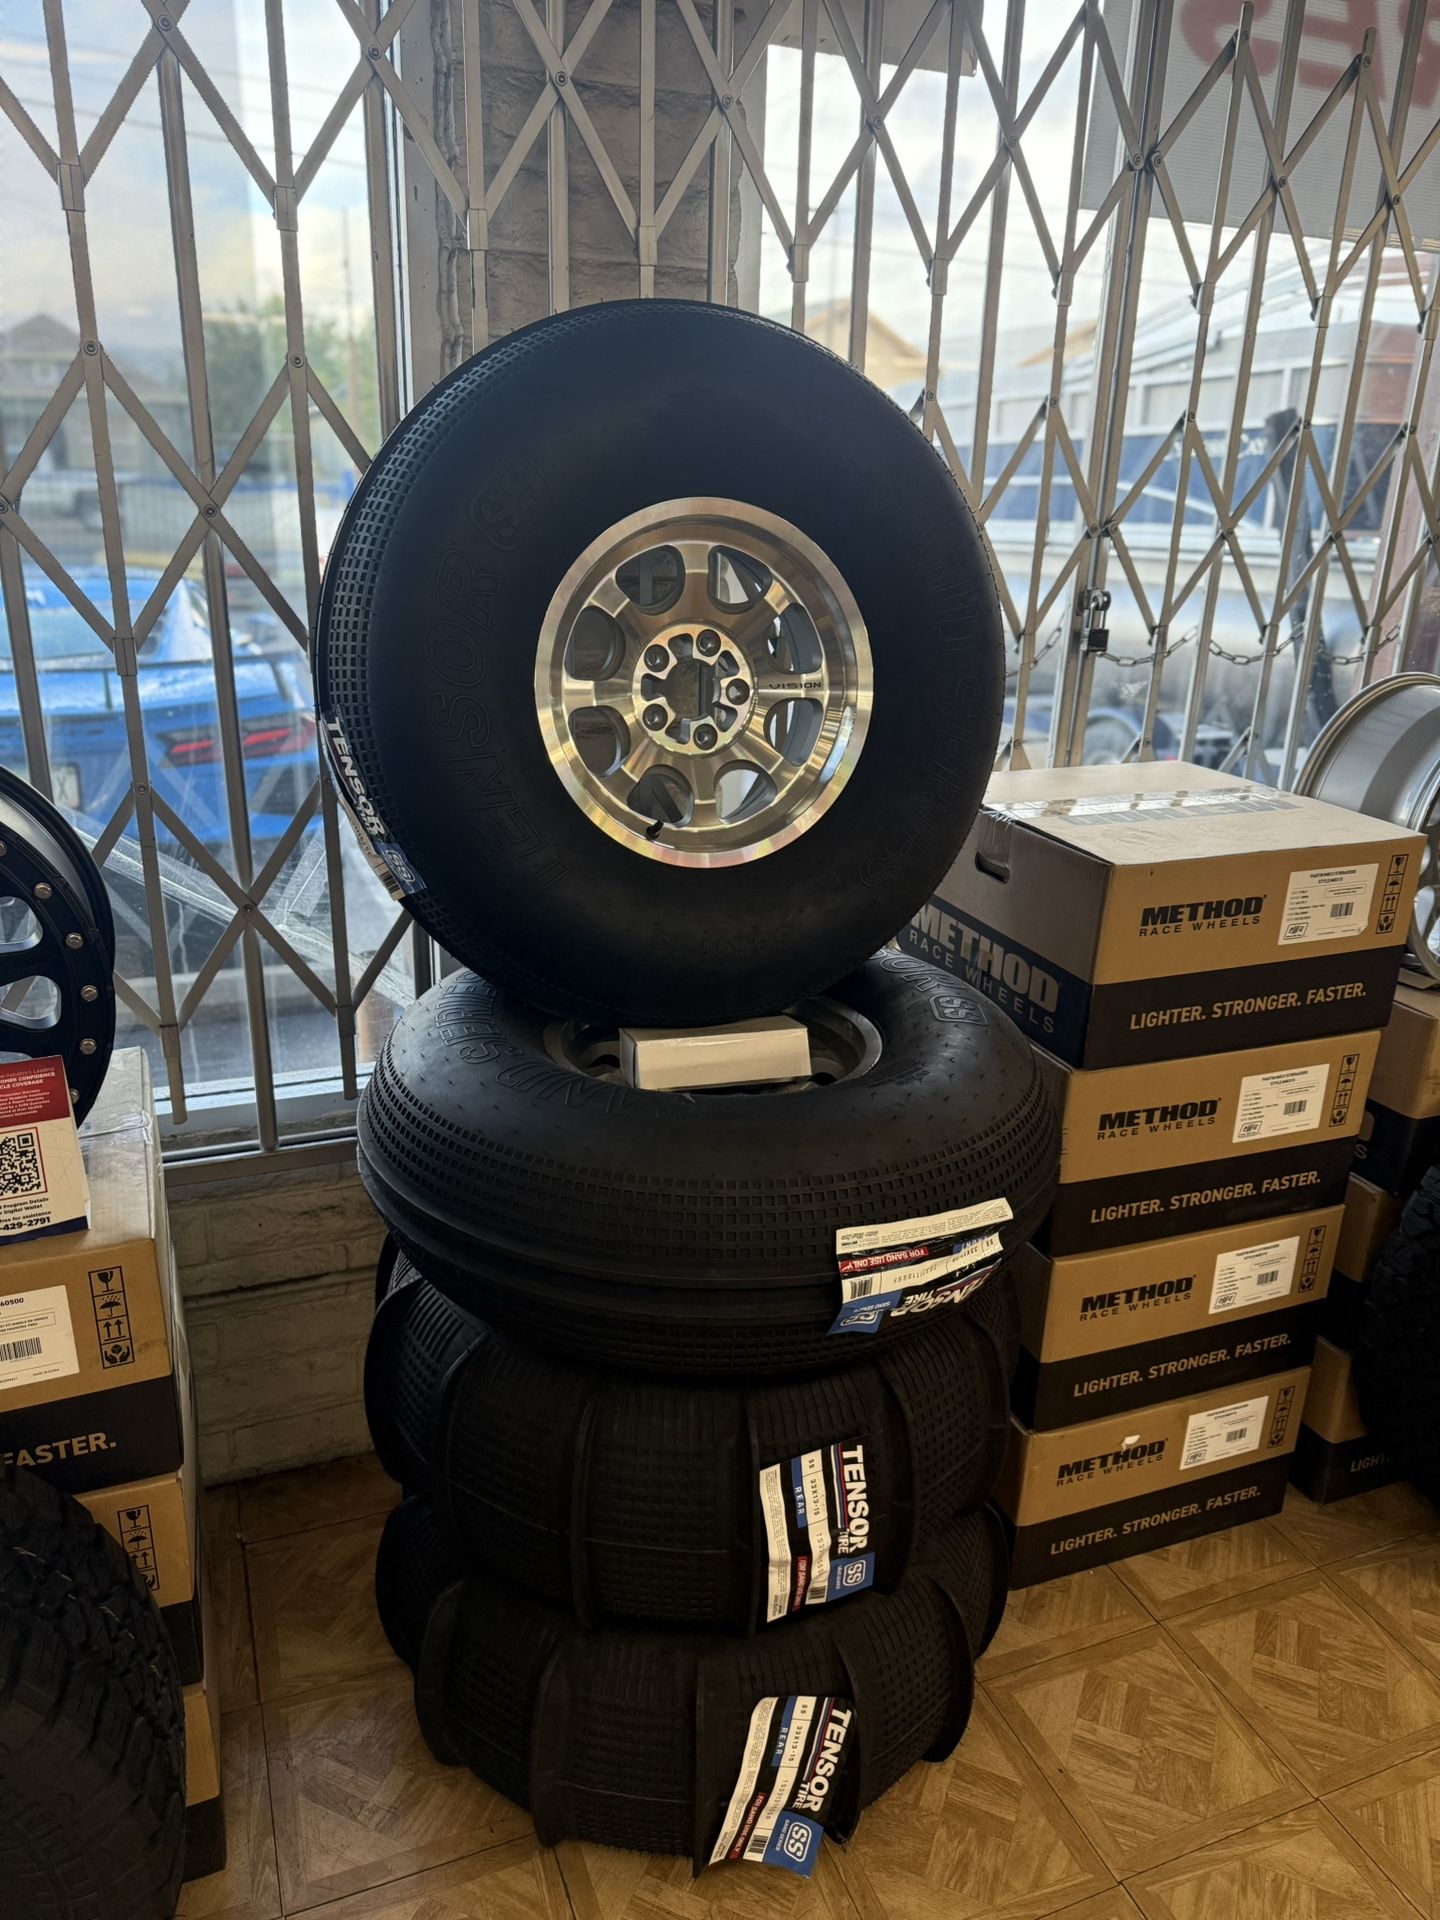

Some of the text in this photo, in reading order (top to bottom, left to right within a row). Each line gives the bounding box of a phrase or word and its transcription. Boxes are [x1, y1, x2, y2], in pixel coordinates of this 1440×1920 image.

[327, 717, 386, 836] TENSOR
[1141, 896, 1265, 927] METHOD
[1139, 916, 1260, 937] RACE WHEELS
[911, 904, 1060, 1013] METHOD
[909, 929, 1054, 1033] RACE WHEELS
[1130, 982, 1367, 1030] LIGHTER. STRONGER. FASTER.
[12, 1079, 43, 1088] COVERAGE
[18, 1072, 55, 1082] CONFIDENCE
[1097, 1117, 1216, 1140] RACE WHEELS
[1098, 1099, 1219, 1131] METHOD
[3, 1201, 28, 1209] Program
[4, 1207, 23, 1215] Digital
[1090, 1170, 1321, 1224] LIGHTER. STRONGER. FASTER.
[22, 1211, 52, 1219] assistance
[847, 1248, 925, 1270] FOR SAND USE ONLY
[904, 1290, 935, 1306] TIRE
[1080, 1292, 1191, 1321] RACE WHEELS
[1081, 1277, 1194, 1313] METHOD
[1073, 1333, 1291, 1397] LIGHTER. STRONGER. FASTER.
[1056, 1472, 1094, 1487] RACE
[1103, 1454, 1163, 1475] WHEELS
[1058, 1440, 1166, 1479] METHOD
[795, 1486, 805, 1515] REAR
[842, 1445, 870, 1554] TENSOR
[1050, 1485, 1261, 1555] LIGHTER. STRONGER. FASTER.
[837, 1528, 850, 1554] TIRE
[846, 1562, 862, 1585] SS
[775, 1727, 789, 1756] REAR
[800, 1708, 852, 1813] TENSOR
[792, 1782, 811, 1810] TIRE
[749, 1807, 758, 1824] SAND
[787, 1825, 807, 1858] SS
